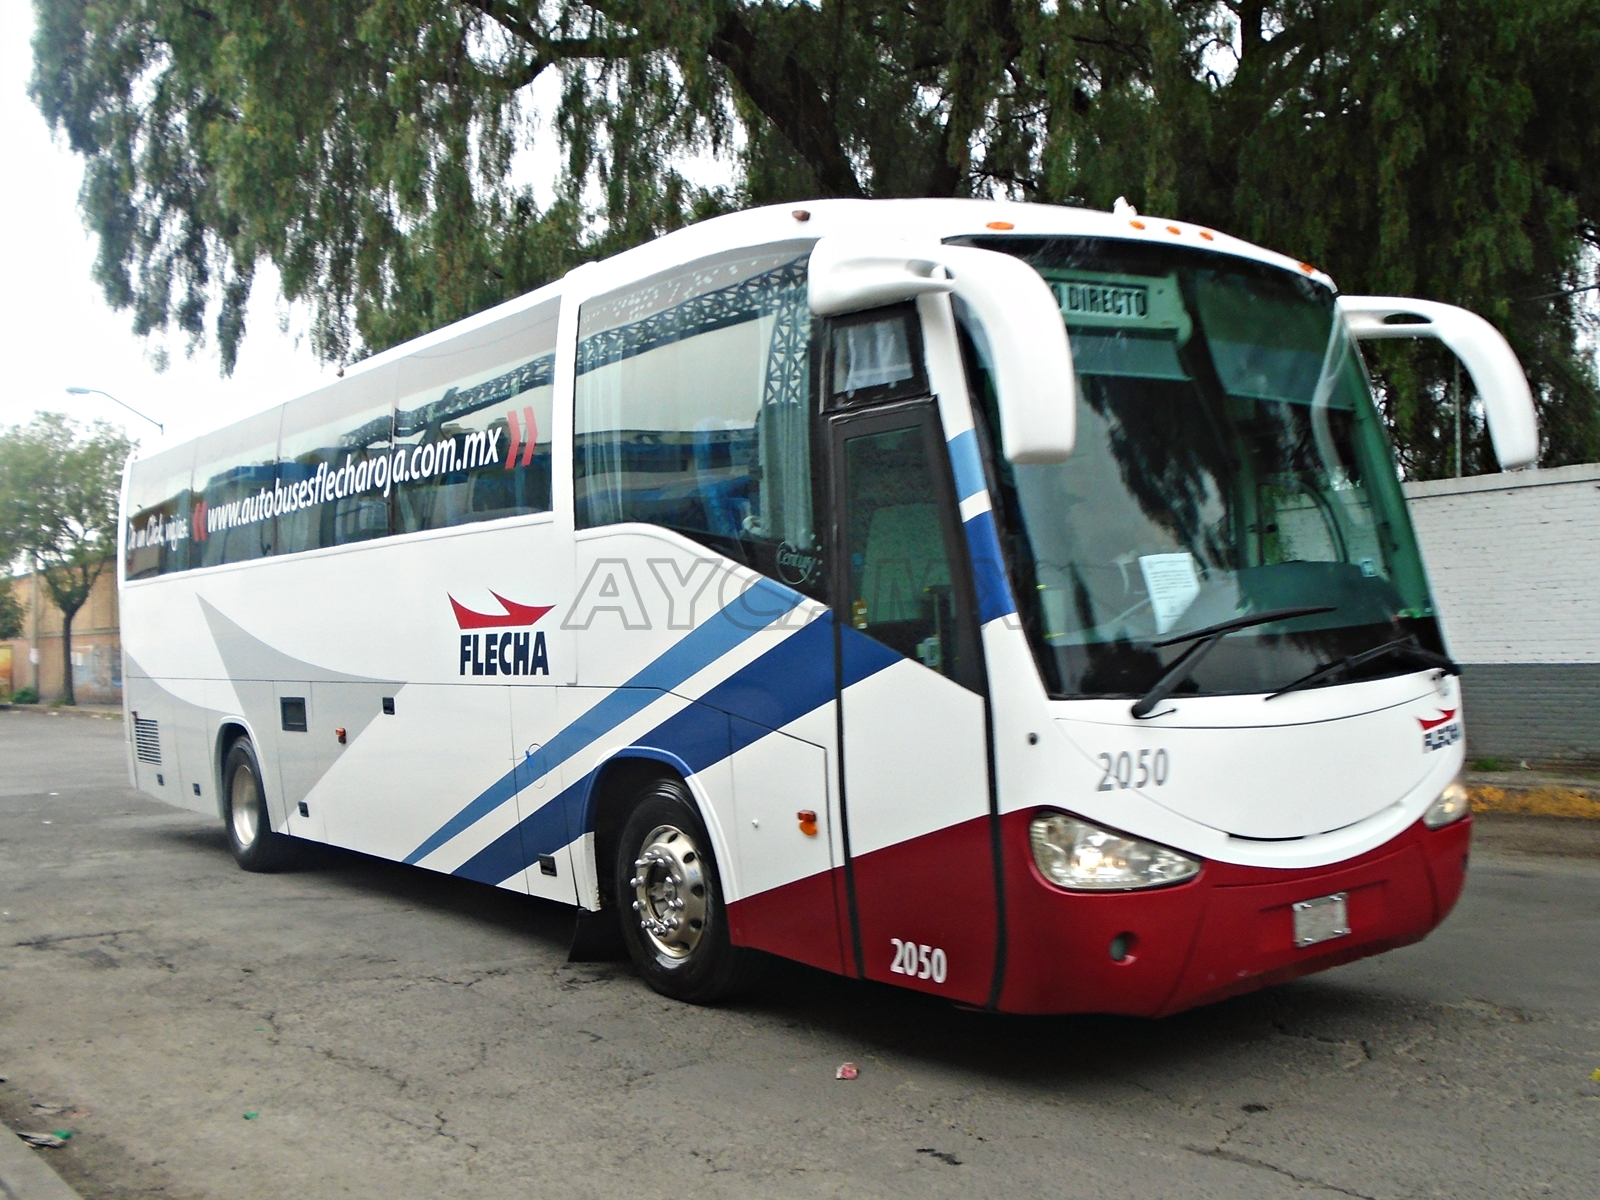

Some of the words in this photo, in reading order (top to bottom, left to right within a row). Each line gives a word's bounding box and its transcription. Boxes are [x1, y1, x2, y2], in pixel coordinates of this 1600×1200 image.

[1068, 285, 1148, 317] DIRECTO
[207, 427, 502, 533] www.autobusesflecharoja.com.mx
[459, 631, 550, 676] FLECHA
[1097, 748, 1170, 792] 2050
[889, 937, 948, 984] 2050
